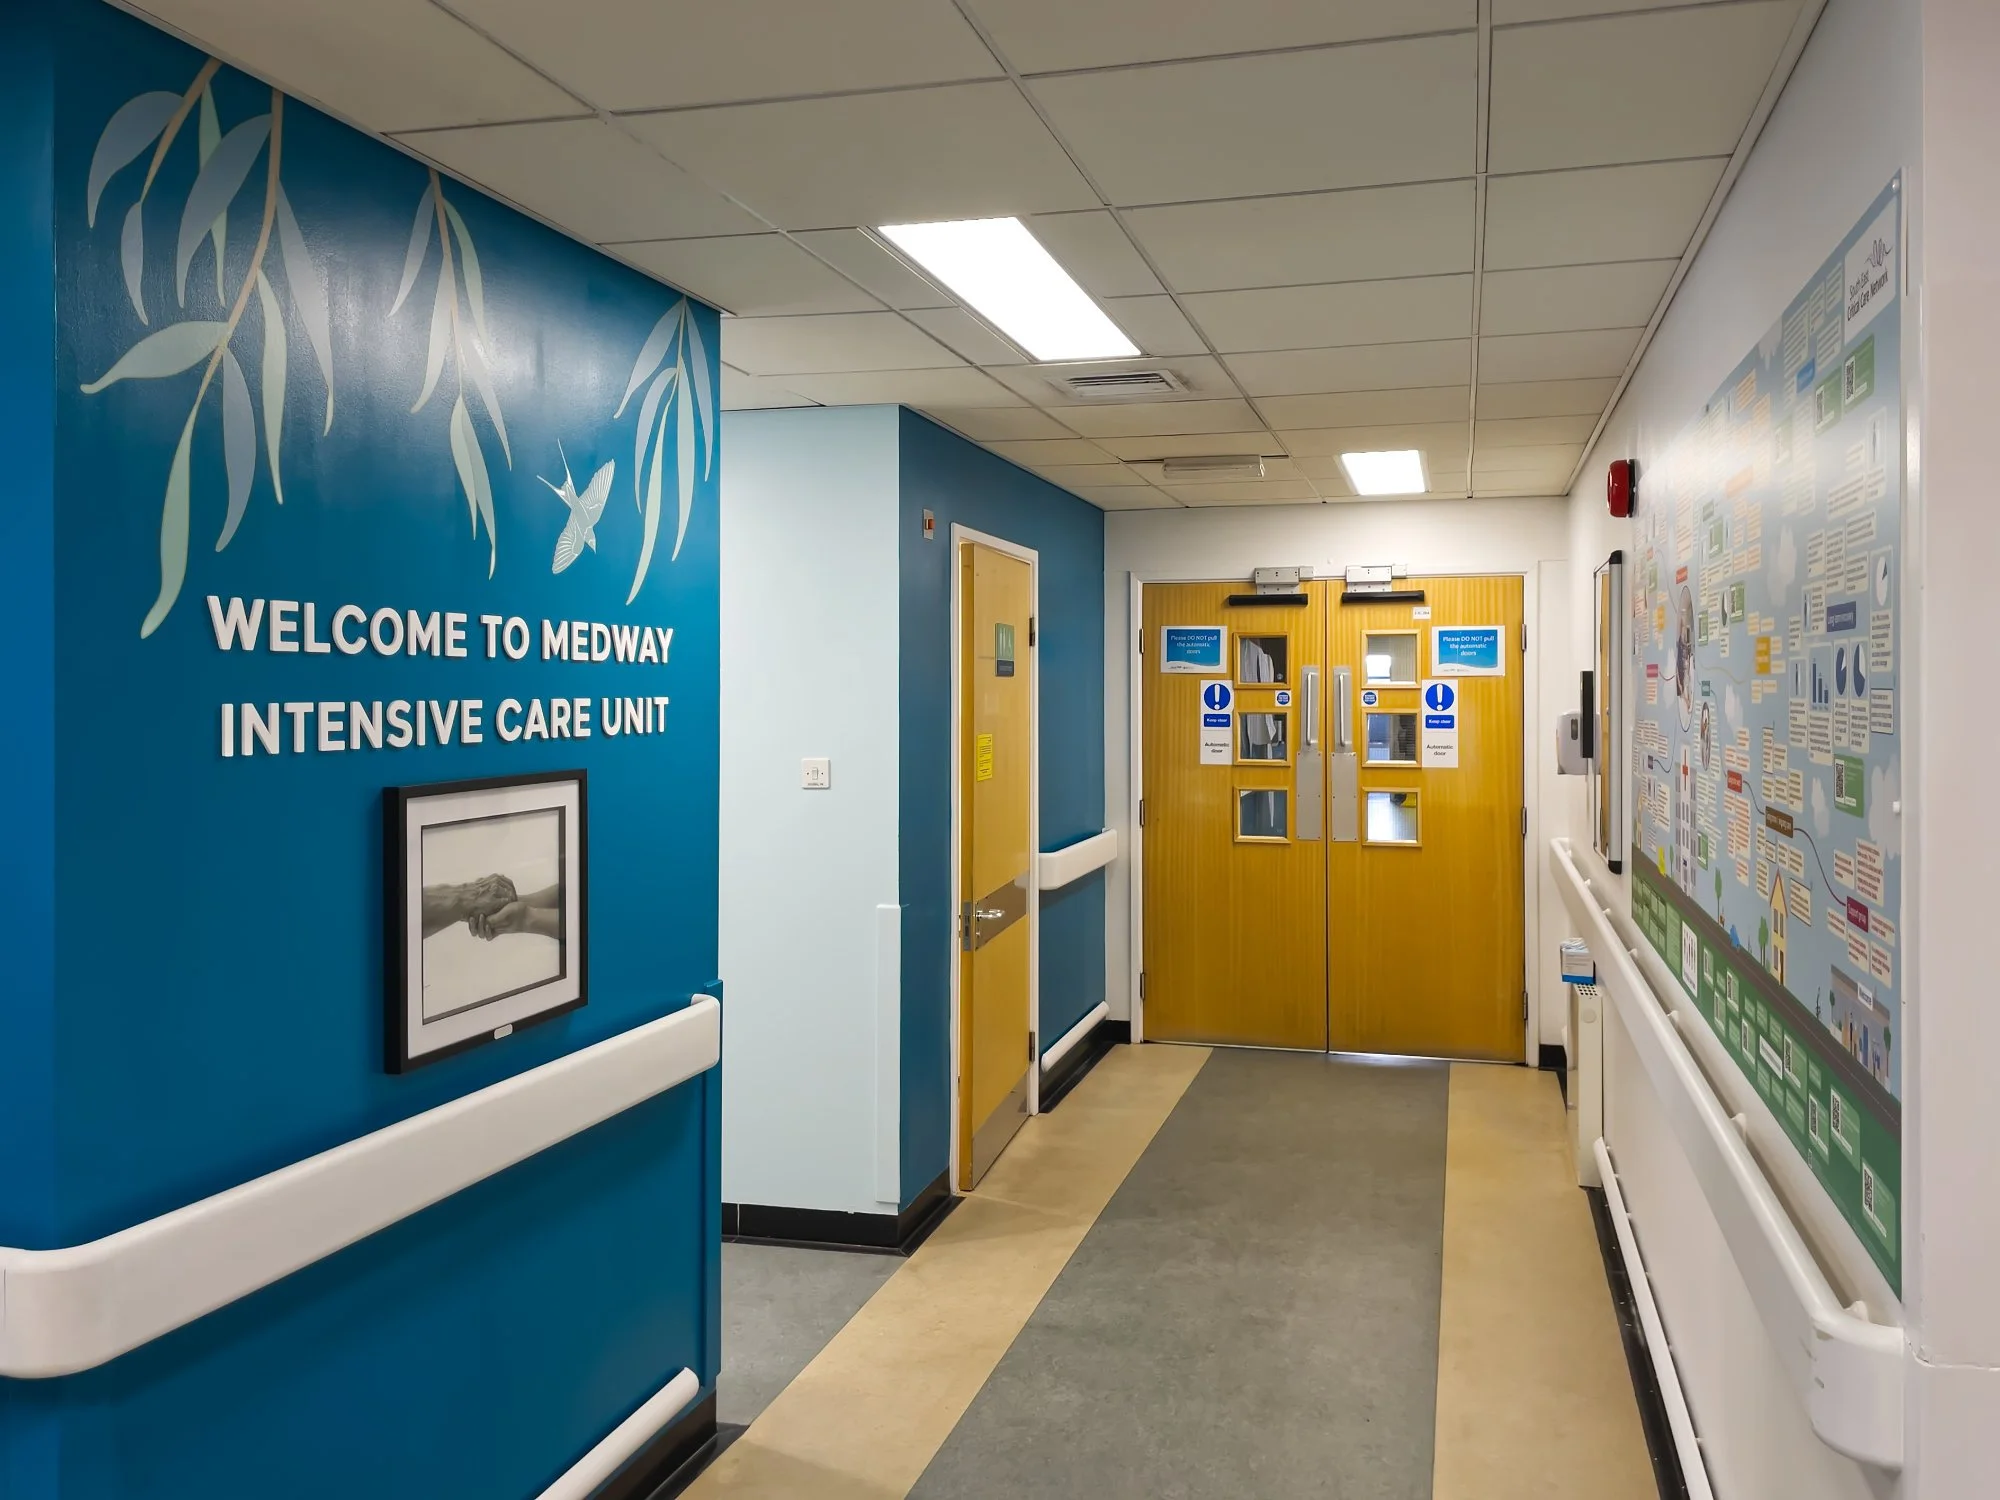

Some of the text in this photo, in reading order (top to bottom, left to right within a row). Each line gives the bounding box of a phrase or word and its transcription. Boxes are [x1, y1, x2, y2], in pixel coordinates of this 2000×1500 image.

[206, 595, 674, 663] WELCOME TO MEDWAY
[221, 696, 670, 757] INTENSIVE CARE UNIT
